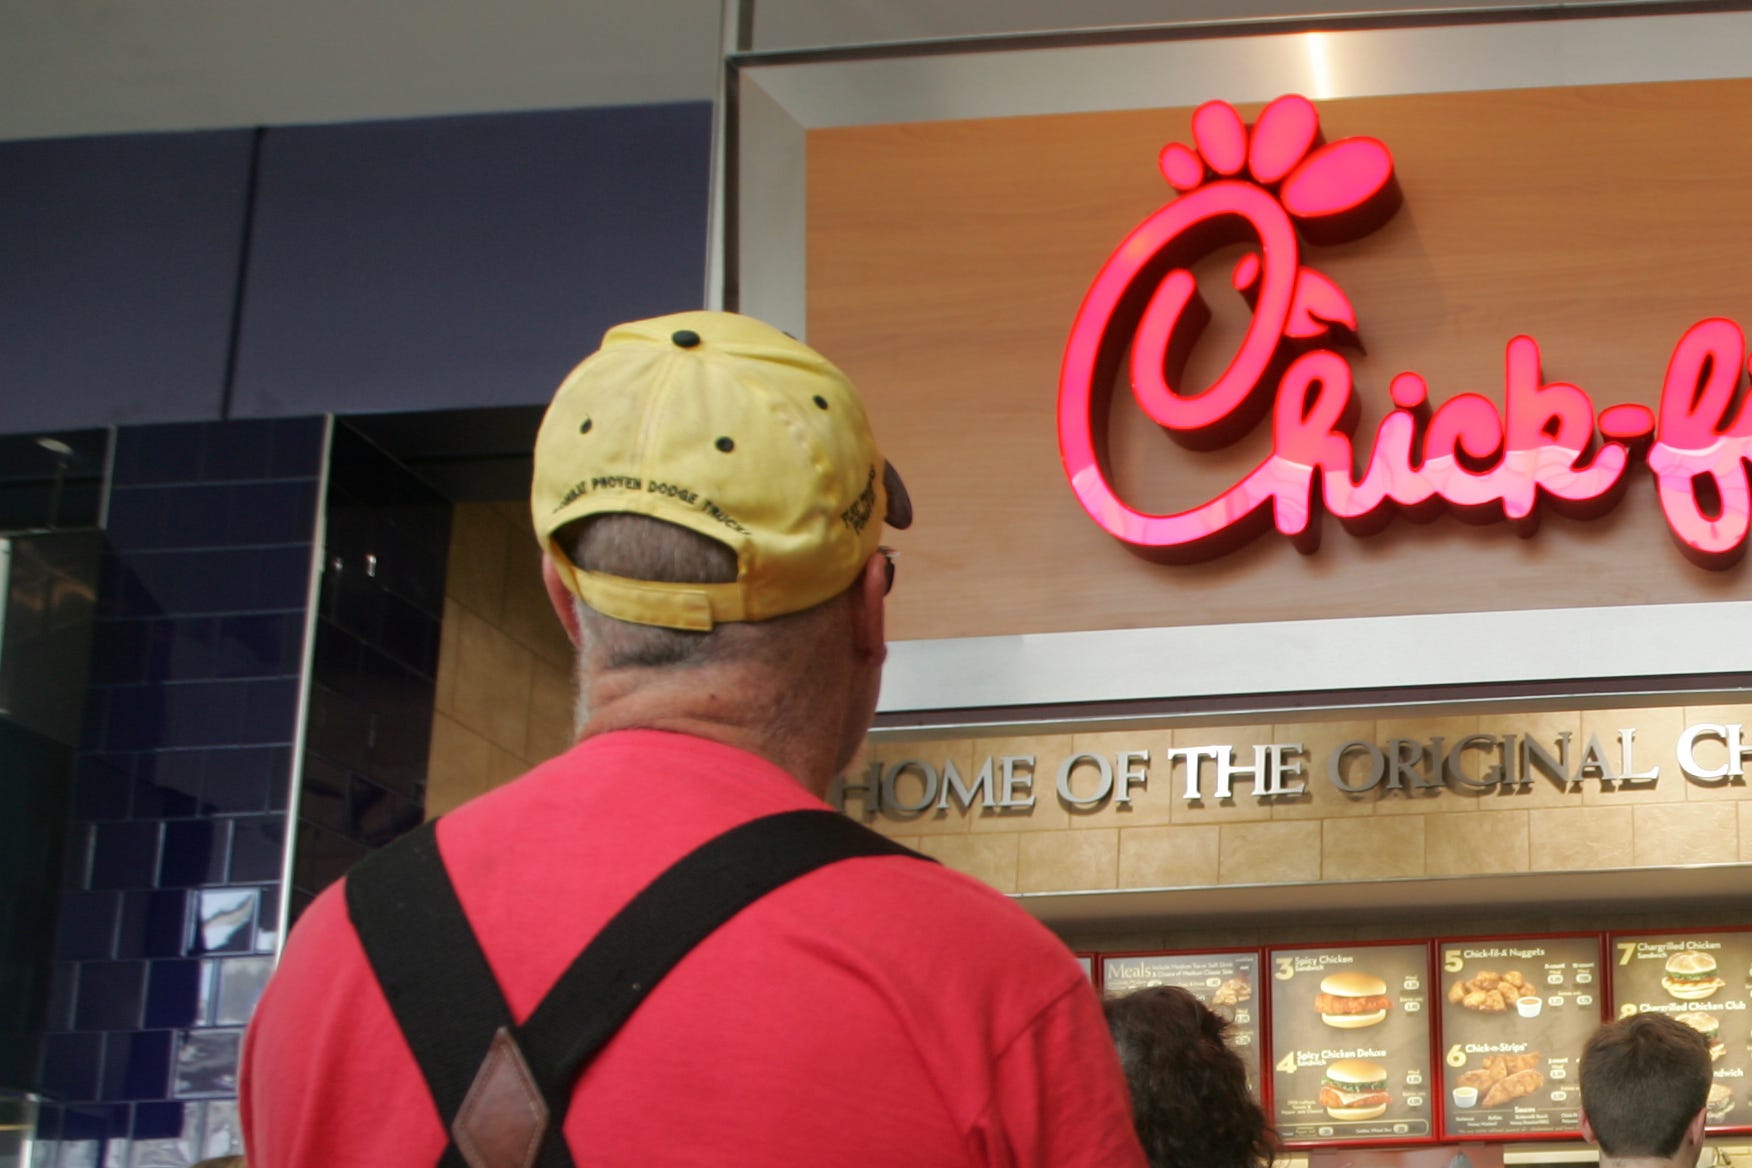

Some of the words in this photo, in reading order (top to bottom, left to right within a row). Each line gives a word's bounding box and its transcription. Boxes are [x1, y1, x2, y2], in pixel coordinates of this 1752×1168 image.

[648, 481, 699, 504] DODGE
[1056, 750, 1150, 804] OF
[1167, 742, 1306, 800] THE
[1328, 727, 1660, 795] ORIGINAL
[1444, 950, 1463, 972] 5
[1510, 949, 1545, 958] Nuggets
[1617, 943, 1636, 965] 7
[1637, 943, 1684, 953] Chargrilled
[1686, 941, 1721, 950] Chicken
[1108, 961, 1151, 978] Meals
[1275, 958, 1294, 980] 3
[1295, 958, 1317, 967] Spicy
[1319, 955, 1353, 964] Chicken
[1640, 1003, 1687, 1013] Chargrilled
[1689, 1002, 1723, 1011] Chicken
[1725, 1001, 1746, 1010] Club
[1276, 1051, 1297, 1073] 4
[1297, 1051, 1319, 1061] Spicy
[1321, 1049, 1355, 1059] Chicken
[1357, 1048, 1386, 1058] Deluxe
[1447, 1044, 1466, 1067] 6
